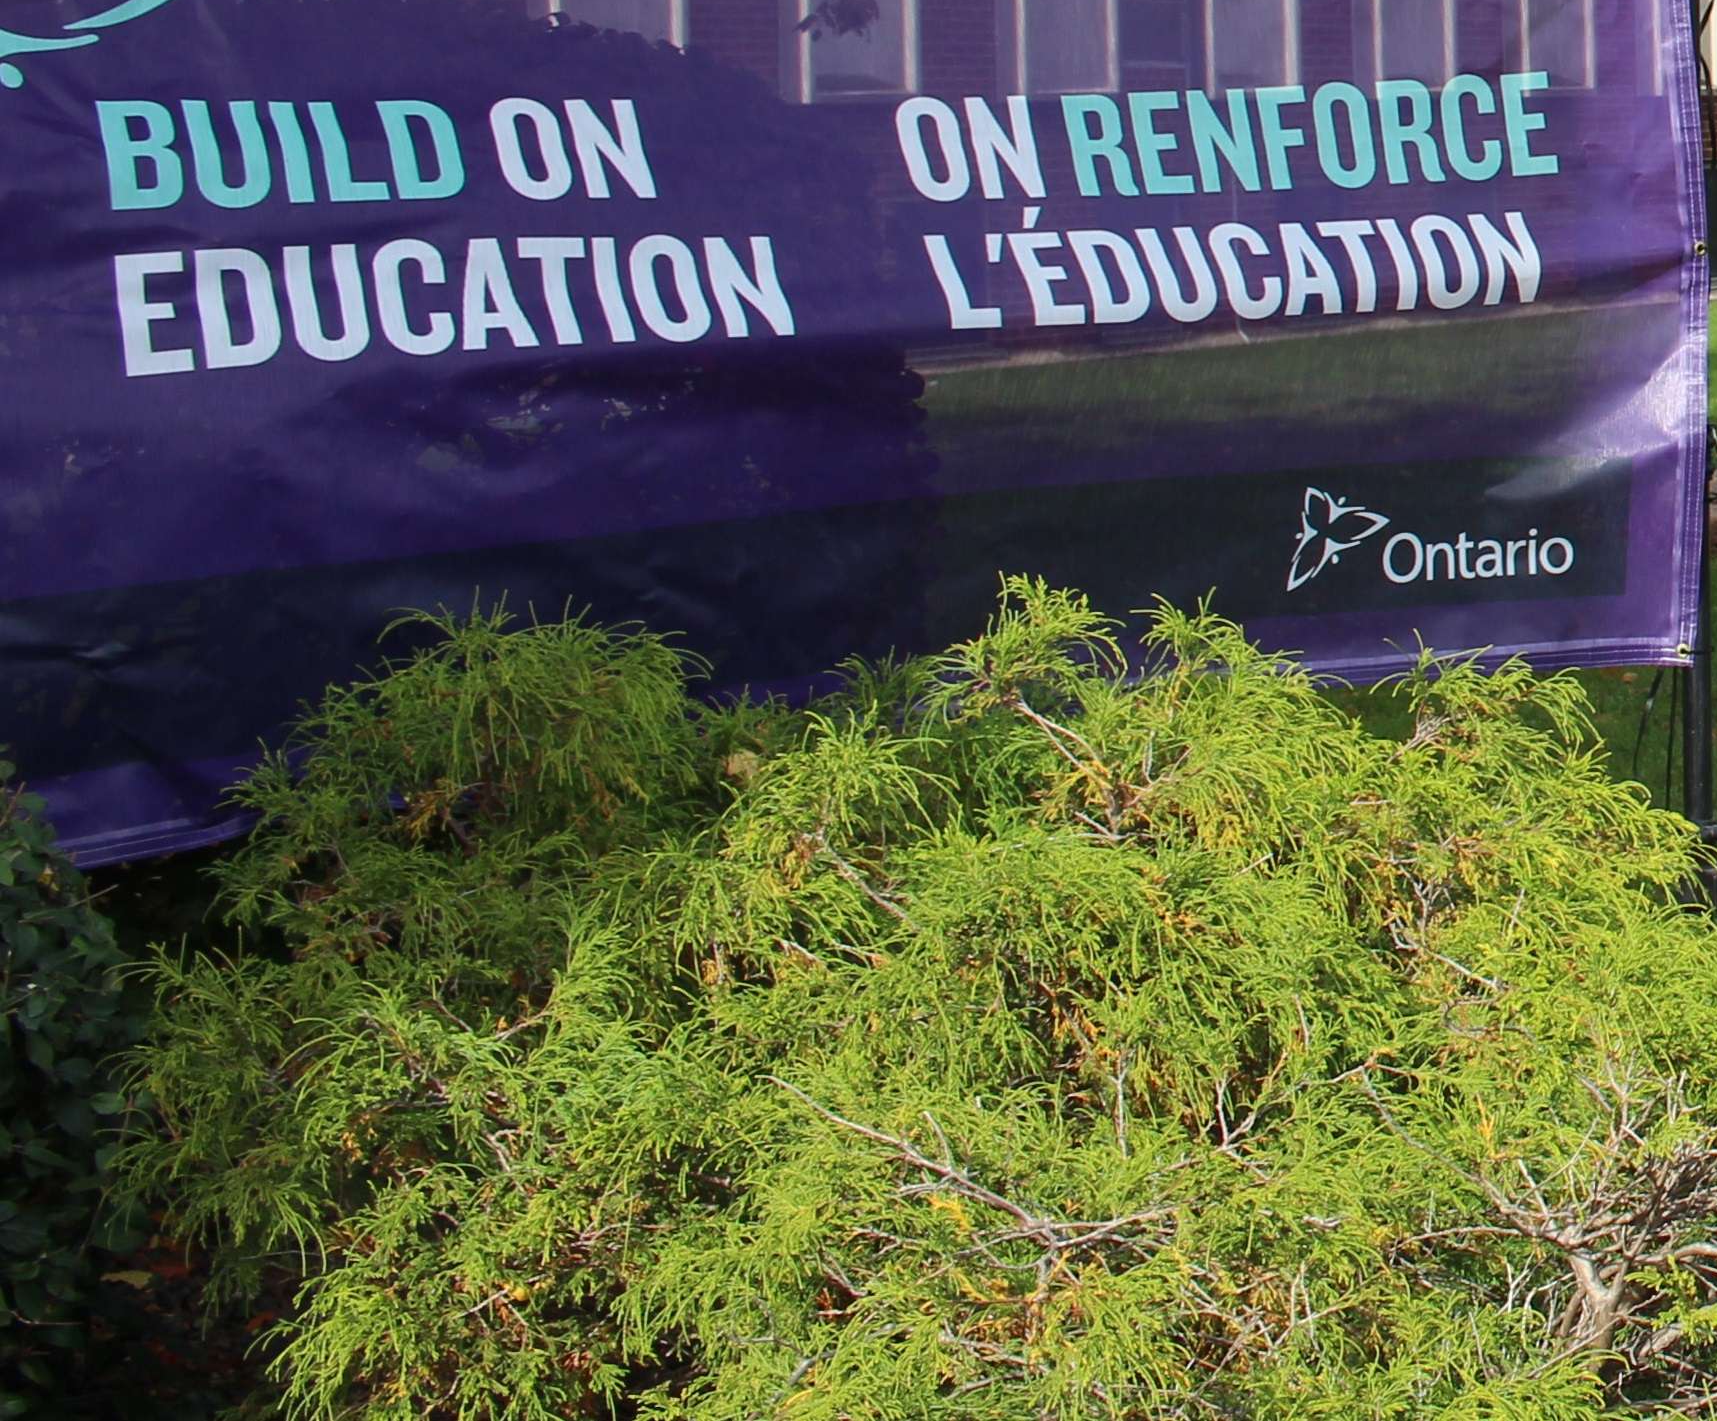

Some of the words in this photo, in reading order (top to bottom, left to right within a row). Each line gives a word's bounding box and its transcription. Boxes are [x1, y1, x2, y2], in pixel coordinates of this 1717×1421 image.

[96, 100, 466, 210] BUILD
[489, 98, 657, 200] ON
[895, 94, 1046, 202] ON
[1061, 70, 1559, 197] RENFORCE
[114, 234, 797, 377] EDUCATION
[924, 206, 1543, 330] L'ÉDUCATION
[1382, 528, 1574, 584] Ontario
